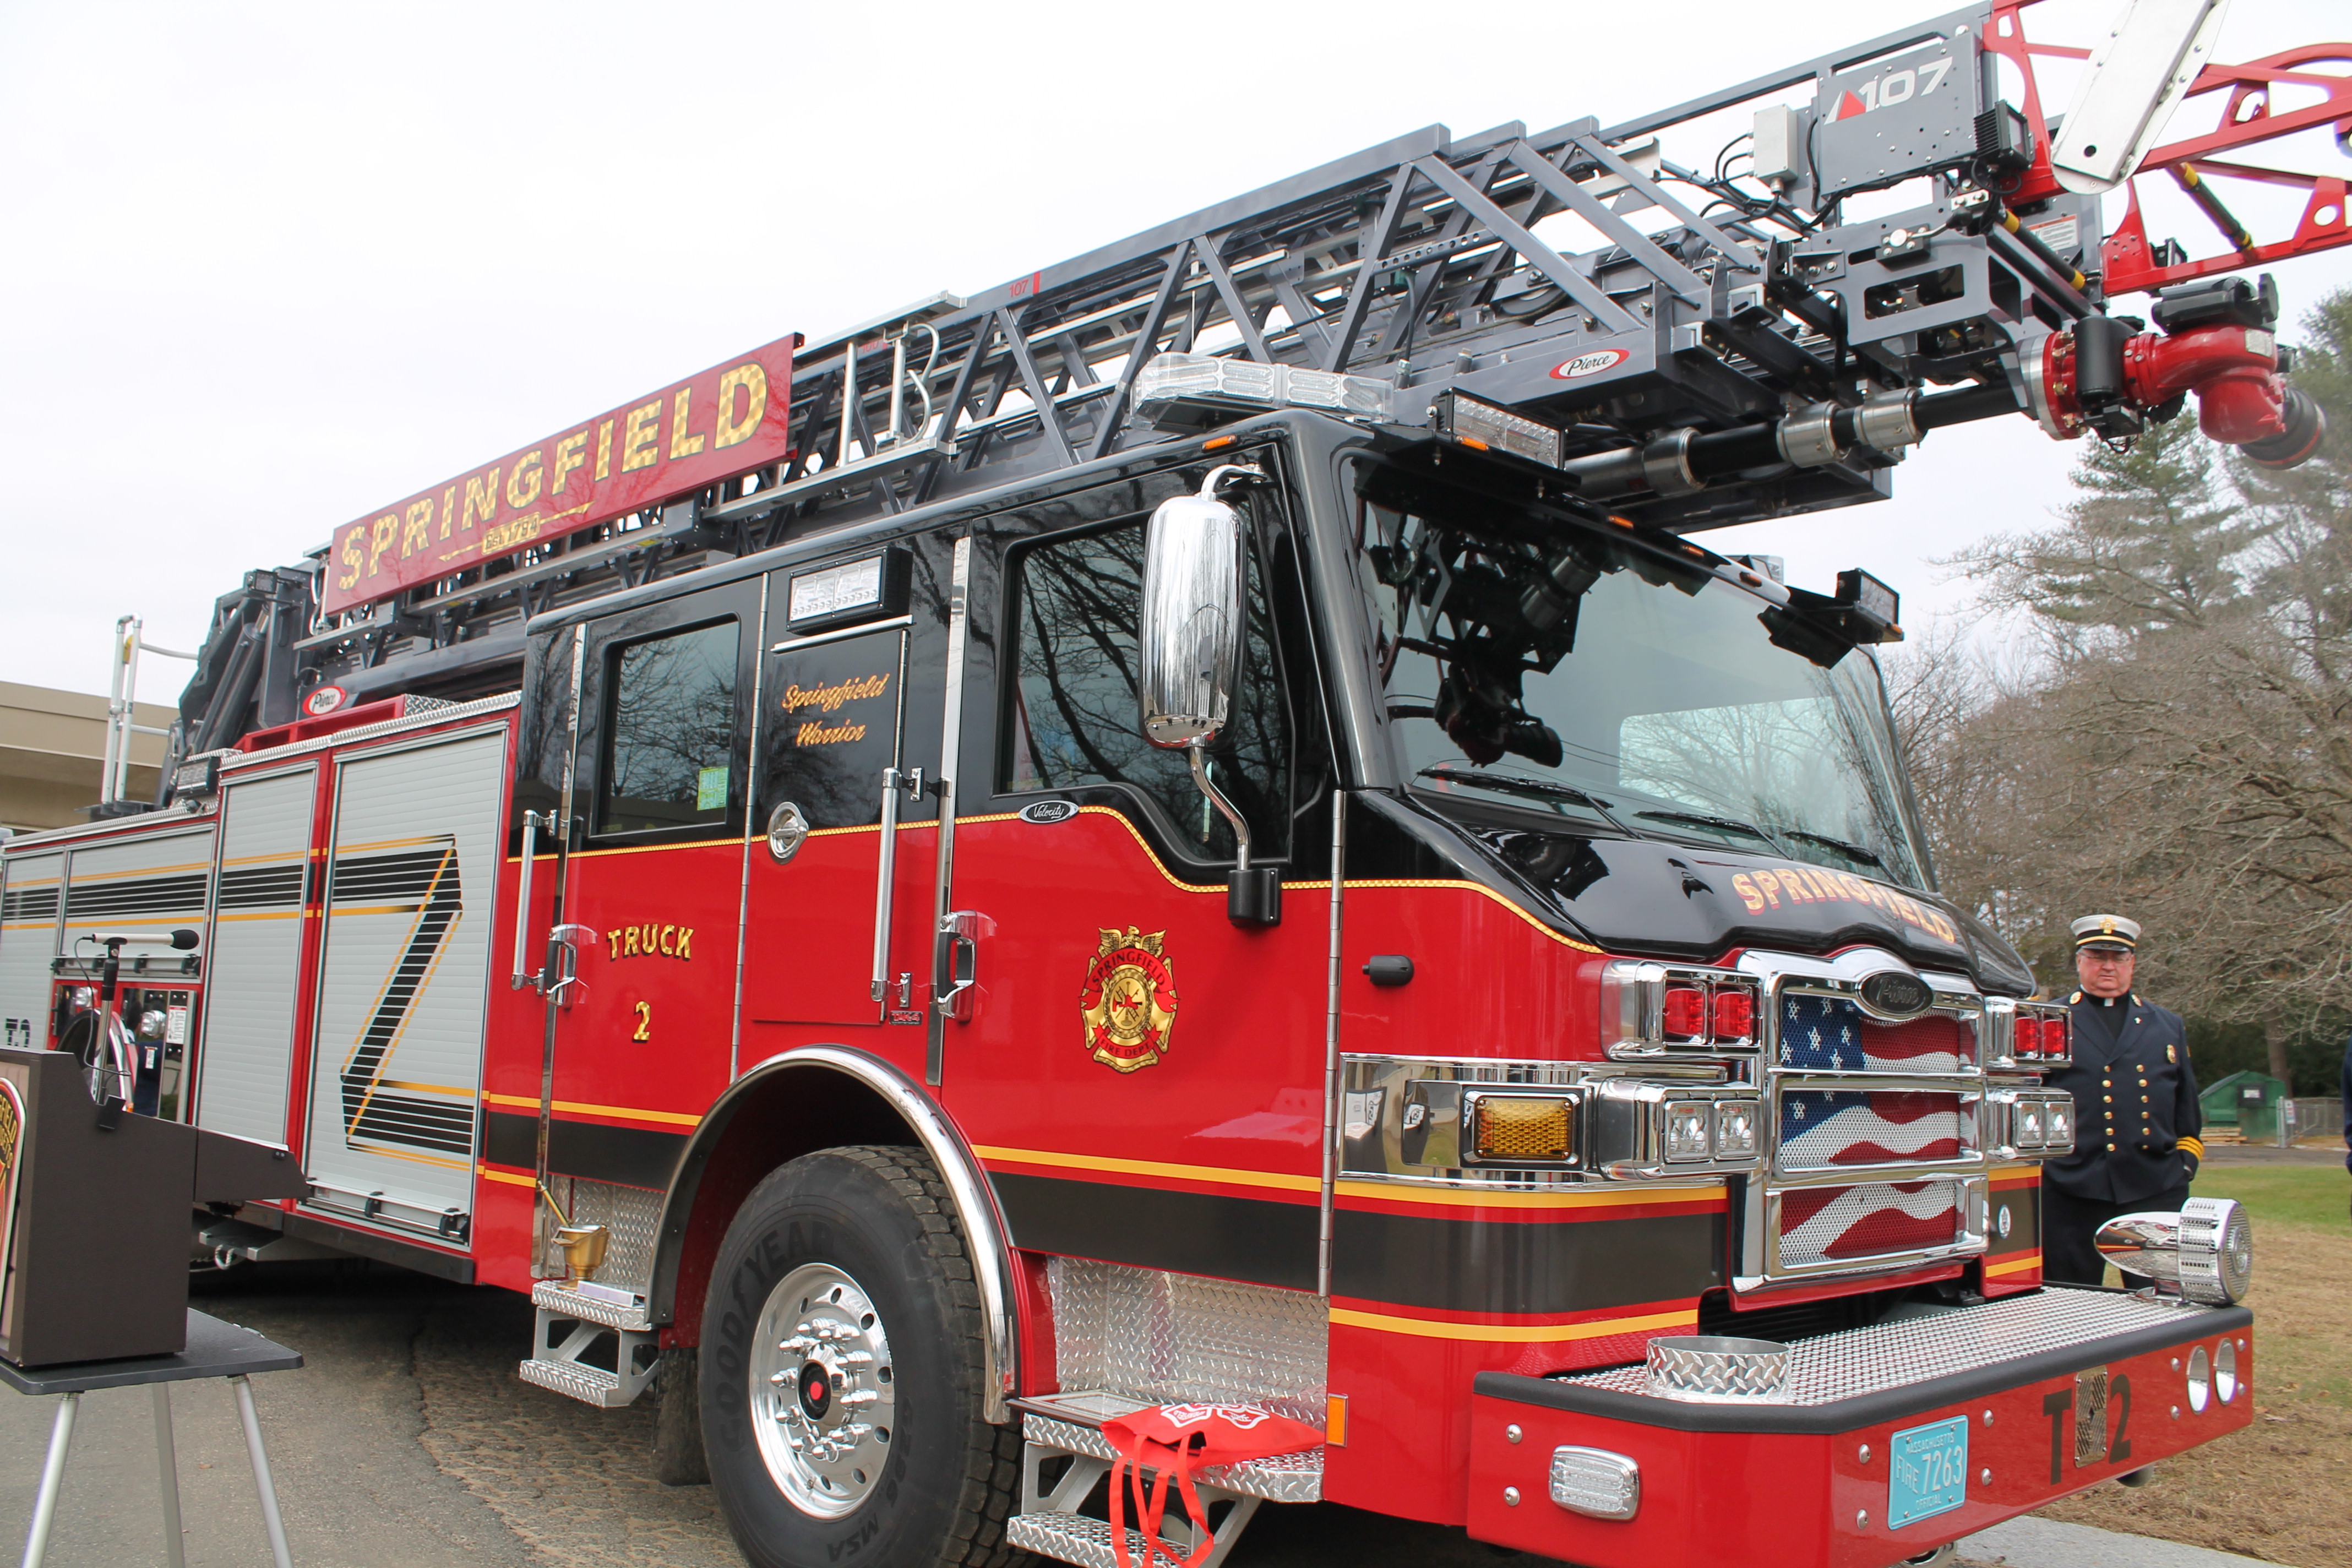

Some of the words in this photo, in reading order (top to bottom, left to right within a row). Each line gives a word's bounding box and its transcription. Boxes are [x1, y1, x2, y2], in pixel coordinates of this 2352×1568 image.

[1009, 279, 1029, 297] 107
[1567, 355, 1610, 375] Pierce
[338, 361, 768, 592] SPRINGFIELD
[508, 518, 538, 542] 1794
[312, 693, 337, 712] Pierce
[781, 672, 890, 714] Springfield
[796, 718, 866, 747] Warrior
[1033, 804, 1065, 820] Velocity
[1732, 868, 1956, 946] SPRINGFIELD
[606, 923, 694, 961] TRUCK
[1092, 950, 1165, 986] SPRINGFIELD
[1875, 975, 1919, 1005] Pierce
[633, 1000, 651, 1041] 2
[1101, 1038, 1120, 1056] FIRE
[716, 1220, 835, 1452] GOODYEAR
[1905, 1432, 1954, 1455] MASSACHUSETTS
[1896, 1452, 1920, 1495] FIRE
[1921, 1445, 1963, 1495] 7263
[1915, 1493, 1942, 1511] OFFICIAL
[826, 1512, 880, 1563] MSA
